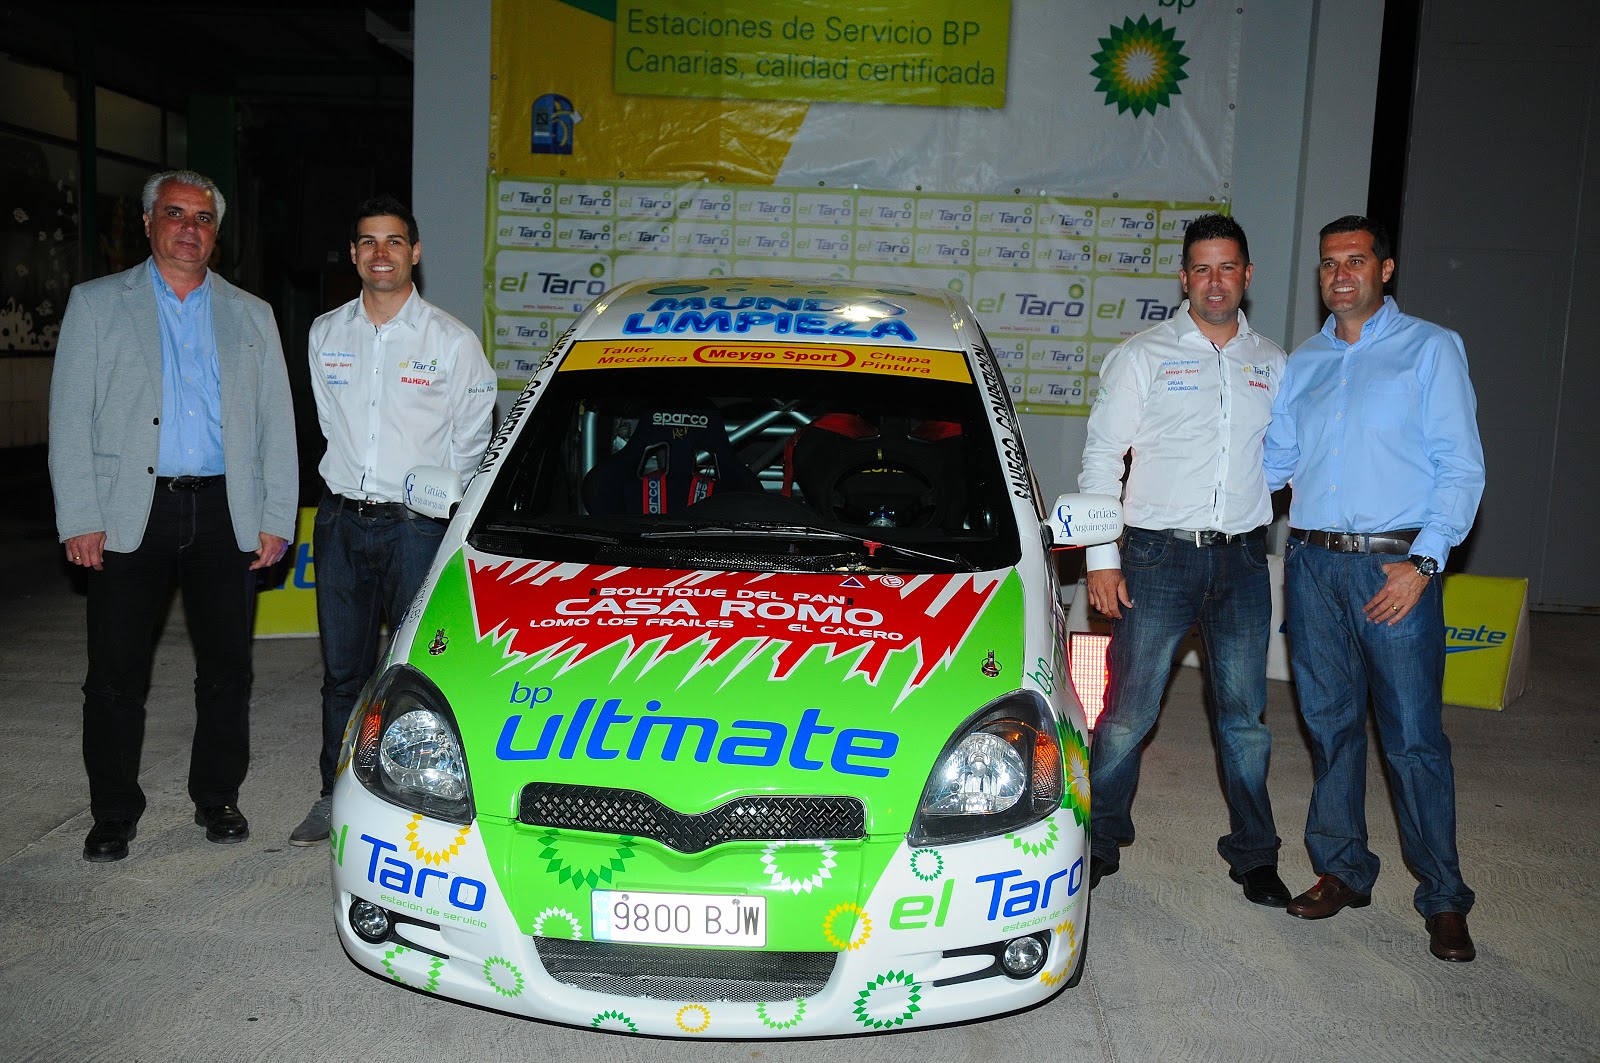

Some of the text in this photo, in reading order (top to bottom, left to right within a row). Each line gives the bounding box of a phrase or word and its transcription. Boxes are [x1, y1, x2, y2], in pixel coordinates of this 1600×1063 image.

[628, 8, 980, 46] Estaciones de Servicio BP
[625, 47, 995, 86] Canarias, calidad certificada
[501, 192, 551, 204] el Taro
[559, 194, 611, 208] el Taro
[619, 196, 671, 210] el Taro
[679, 198, 730, 212] el Taro
[739, 201, 791, 214] el Taro
[799, 204, 850, 217] el Taro
[860, 206, 911, 219] el Taro
[919, 209, 971, 222] el Taro
[979, 212, 1032, 224] el Taro
[1040, 214, 1092, 227] el Taro
[1101, 217, 1154, 230] el Taro
[1162, 220, 1176, 230] el
[500, 226, 551, 239] el Taro
[559, 229, 610, 241] el Taro
[619, 231, 670, 243] el Taro
[678, 233, 729, 246] el Taro
[738, 236, 790, 248] el Taro
[797, 238, 849, 251] el Taro
[858, 241, 910, 254] el Taro
[918, 244, 970, 256] el Taro
[977, 246, 1030, 259] el Taro
[1038, 250, 1090, 261] el Taro
[1099, 252, 1151, 265] el Taro
[1159, 254, 1173, 264] el
[500, 272, 605, 296] el Taro
[976, 292, 1085, 318] el Taro
[1097, 298, 1180, 320] el Tar
[496, 326, 509, 336] el
[515, 326, 548, 338] Taro
[622, 310, 918, 342] LIMPIEZA
[603, 346, 654, 355] Taller
[708, 349, 838, 362] Meygo Sport
[1032, 350, 1084, 362] el Taro
[597, 355, 688, 364] Mecánica
[869, 351, 931, 364] Chapa
[412, 361, 436, 372] Taro
[496, 360, 539, 371] el Tar
[860, 361, 931, 374] Pintura
[1253, 366, 1270, 377] Taro
[1030, 384, 1043, 394] el
[1048, 384, 1080, 396] Taro
[652, 412, 709, 427] sparco
[424, 484, 448, 500] Grúas
[648, 480, 658, 514] arco
[1088, 508, 1118, 520] Grúas
[599, 587, 846, 604] BOUTIQUE DEL PAN
[555, 598, 884, 627] CASA ROMO
[529, 618, 590, 628] LOMO
[596, 618, 638, 626] LOS
[646, 618, 735, 628] FRAILES
[788, 624, 818, 633] EL
[820, 626, 904, 641] CALERO
[1445, 625, 1507, 644] mate
[1026, 657, 1057, 696] bp
[510, 682, 554, 710] bp
[496, 699, 900, 778] ultimate
[360, 833, 487, 912] Taro
[888, 856, 1084, 930] el Taro
[425, 907, 440, 917] de
[1049, 909, 1061, 920] de
[614, 902, 760, 936] 9800 BJW
